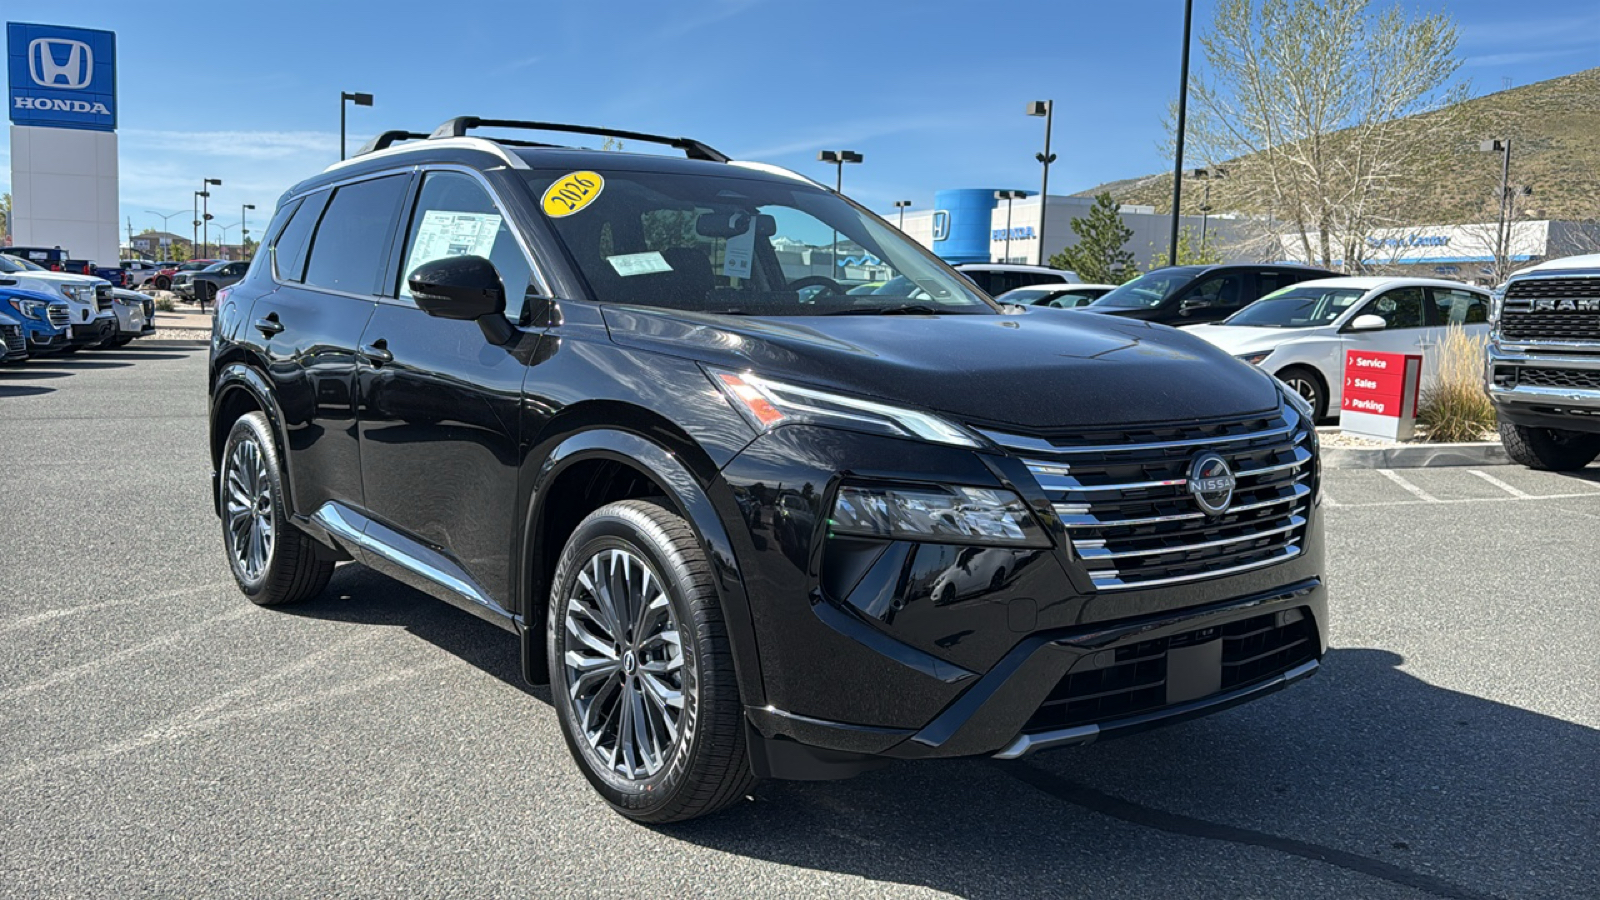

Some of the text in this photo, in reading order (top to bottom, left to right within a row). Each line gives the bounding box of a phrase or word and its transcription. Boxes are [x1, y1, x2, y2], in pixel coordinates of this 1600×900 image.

[14, 96, 111, 115] HONDA
[551, 175, 595, 210] 2026
[1535, 300, 1600, 311] RAM
[1356, 357, 1387, 369] Service
[1354, 378, 1377, 389] Sales
[1352, 399, 1385, 413] Parking
[1191, 478, 1236, 490] NISSAN
